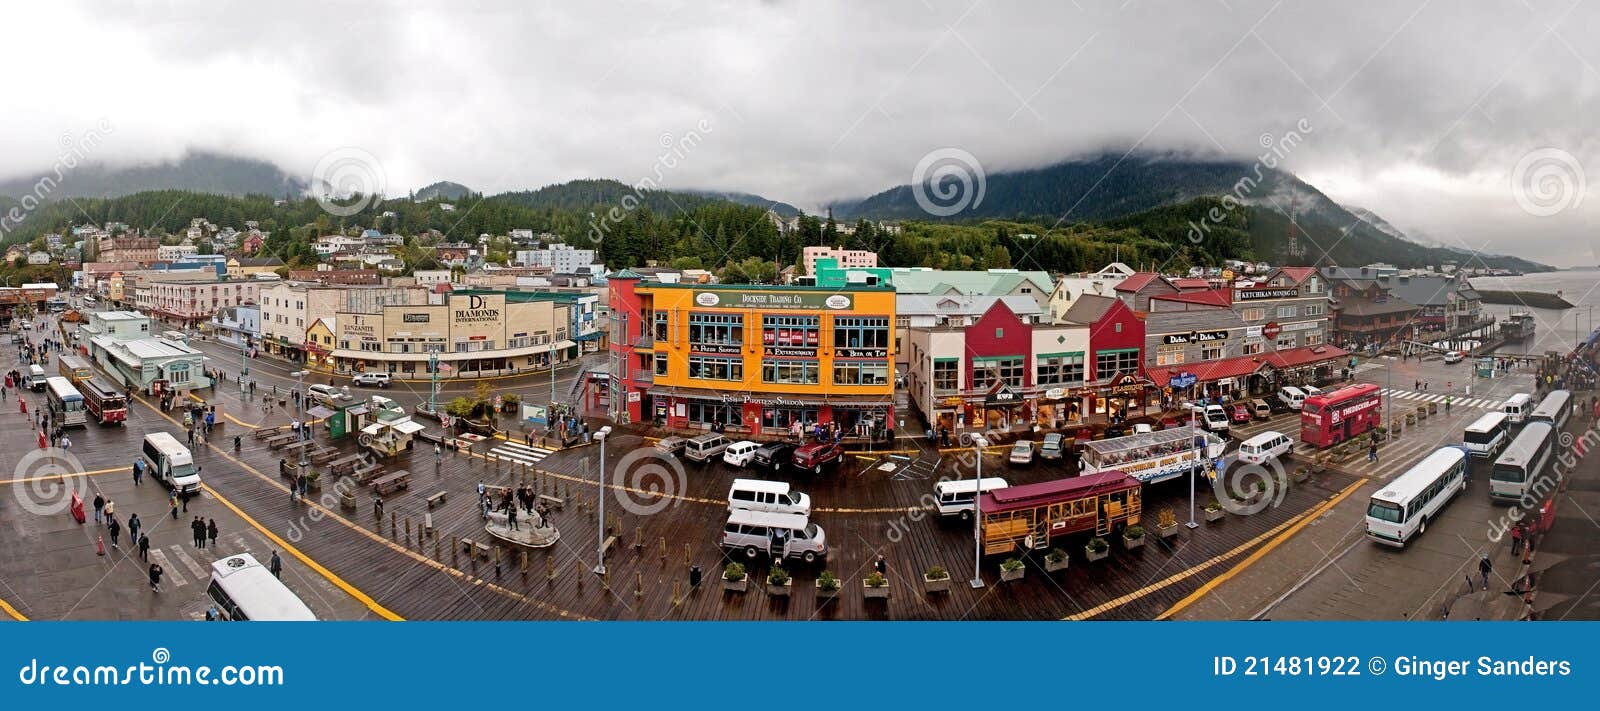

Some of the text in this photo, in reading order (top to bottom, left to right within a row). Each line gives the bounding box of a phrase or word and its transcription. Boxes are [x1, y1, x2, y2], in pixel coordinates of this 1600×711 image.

[1241, 289, 1272, 299] KETCHIKAN
[1272, 289, 1291, 297] MINING
[455, 309, 499, 318] DIAMONDS
[344, 324, 374, 332] TANZANITE
